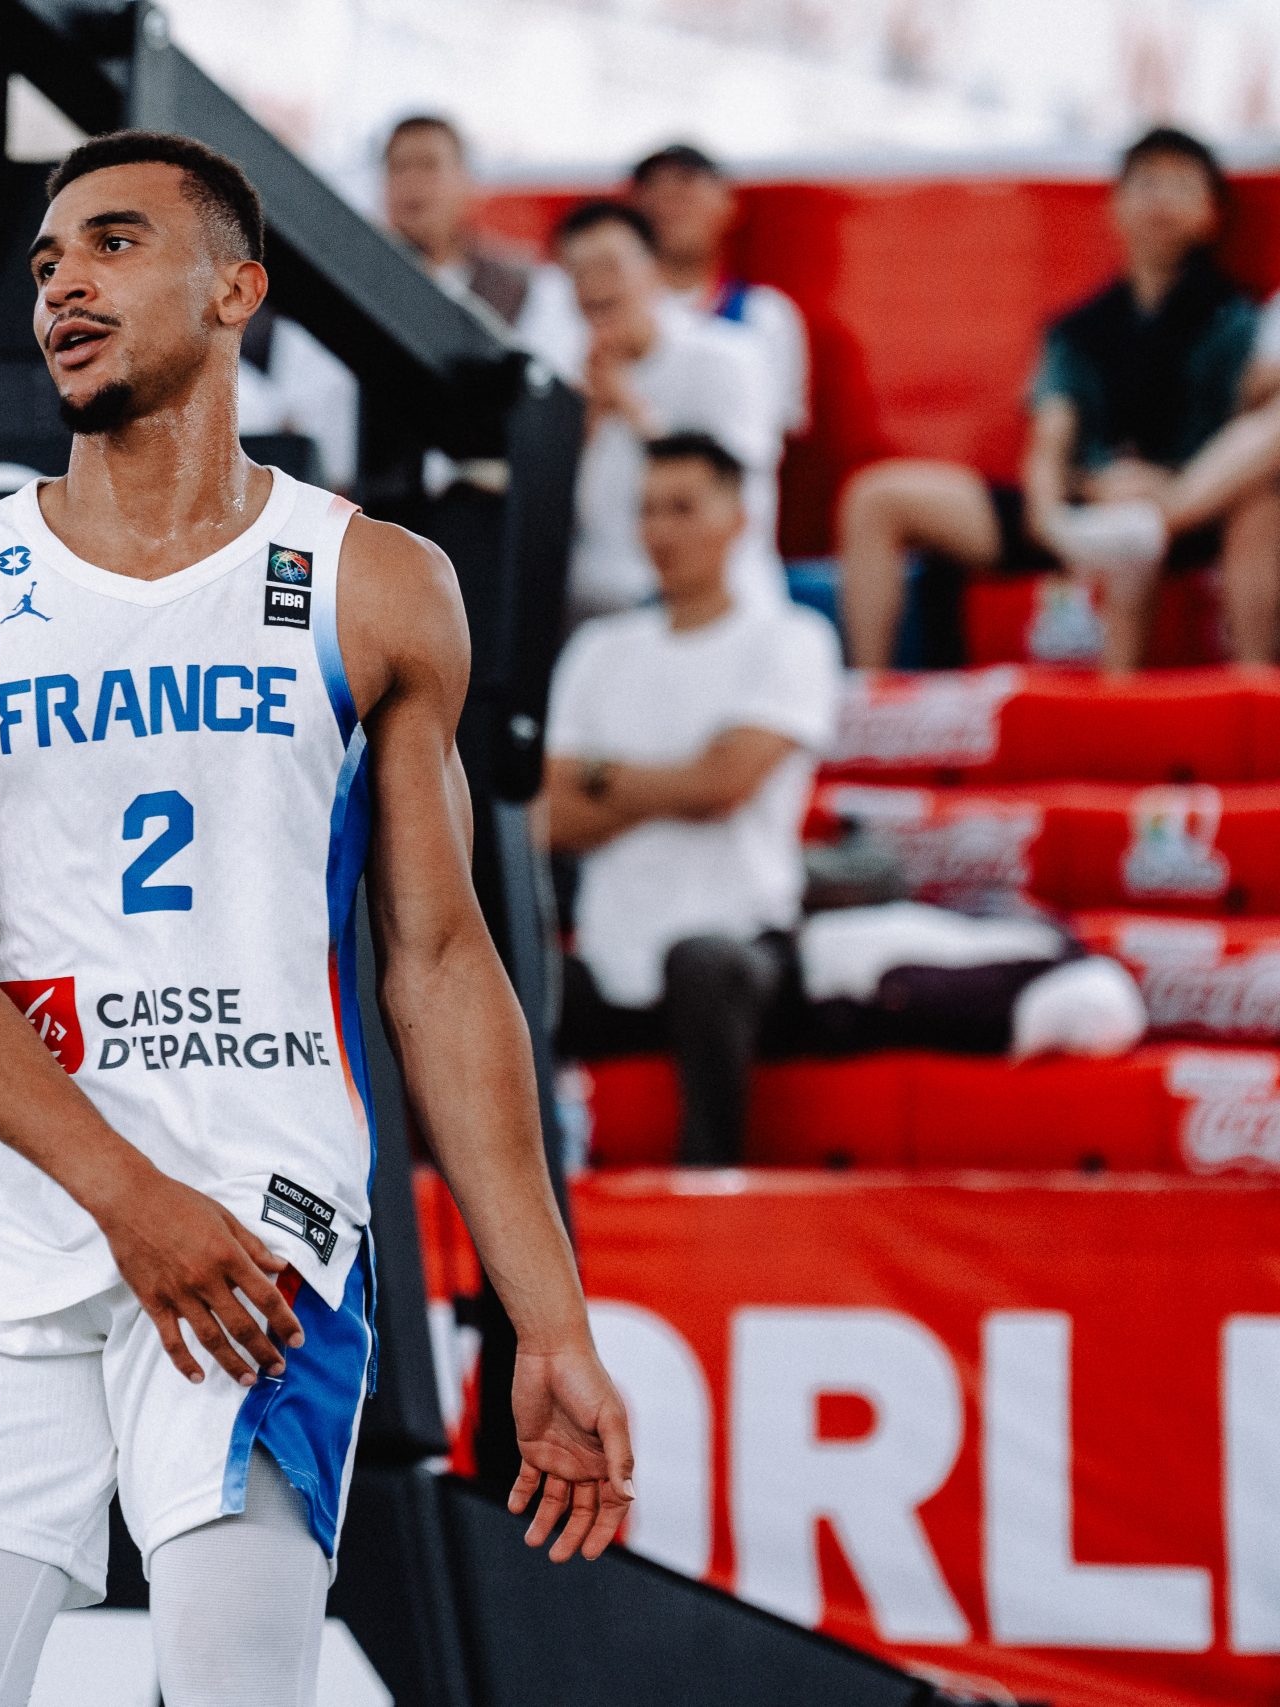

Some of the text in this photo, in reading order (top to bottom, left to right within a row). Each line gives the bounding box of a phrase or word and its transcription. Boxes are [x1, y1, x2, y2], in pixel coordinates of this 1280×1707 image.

[271, 591, 304, 609] FIBA
[122, 790, 194, 915] 2
[96, 987, 241, 1029] CAISSE
[98, 1031, 330, 1071] D'EPARGNE
[275, 1180, 303, 1202] TOUTES
[301, 1197, 313, 1207] ET
[312, 1203, 332, 1221] TOUS
[309, 1227, 326, 1246] 48
